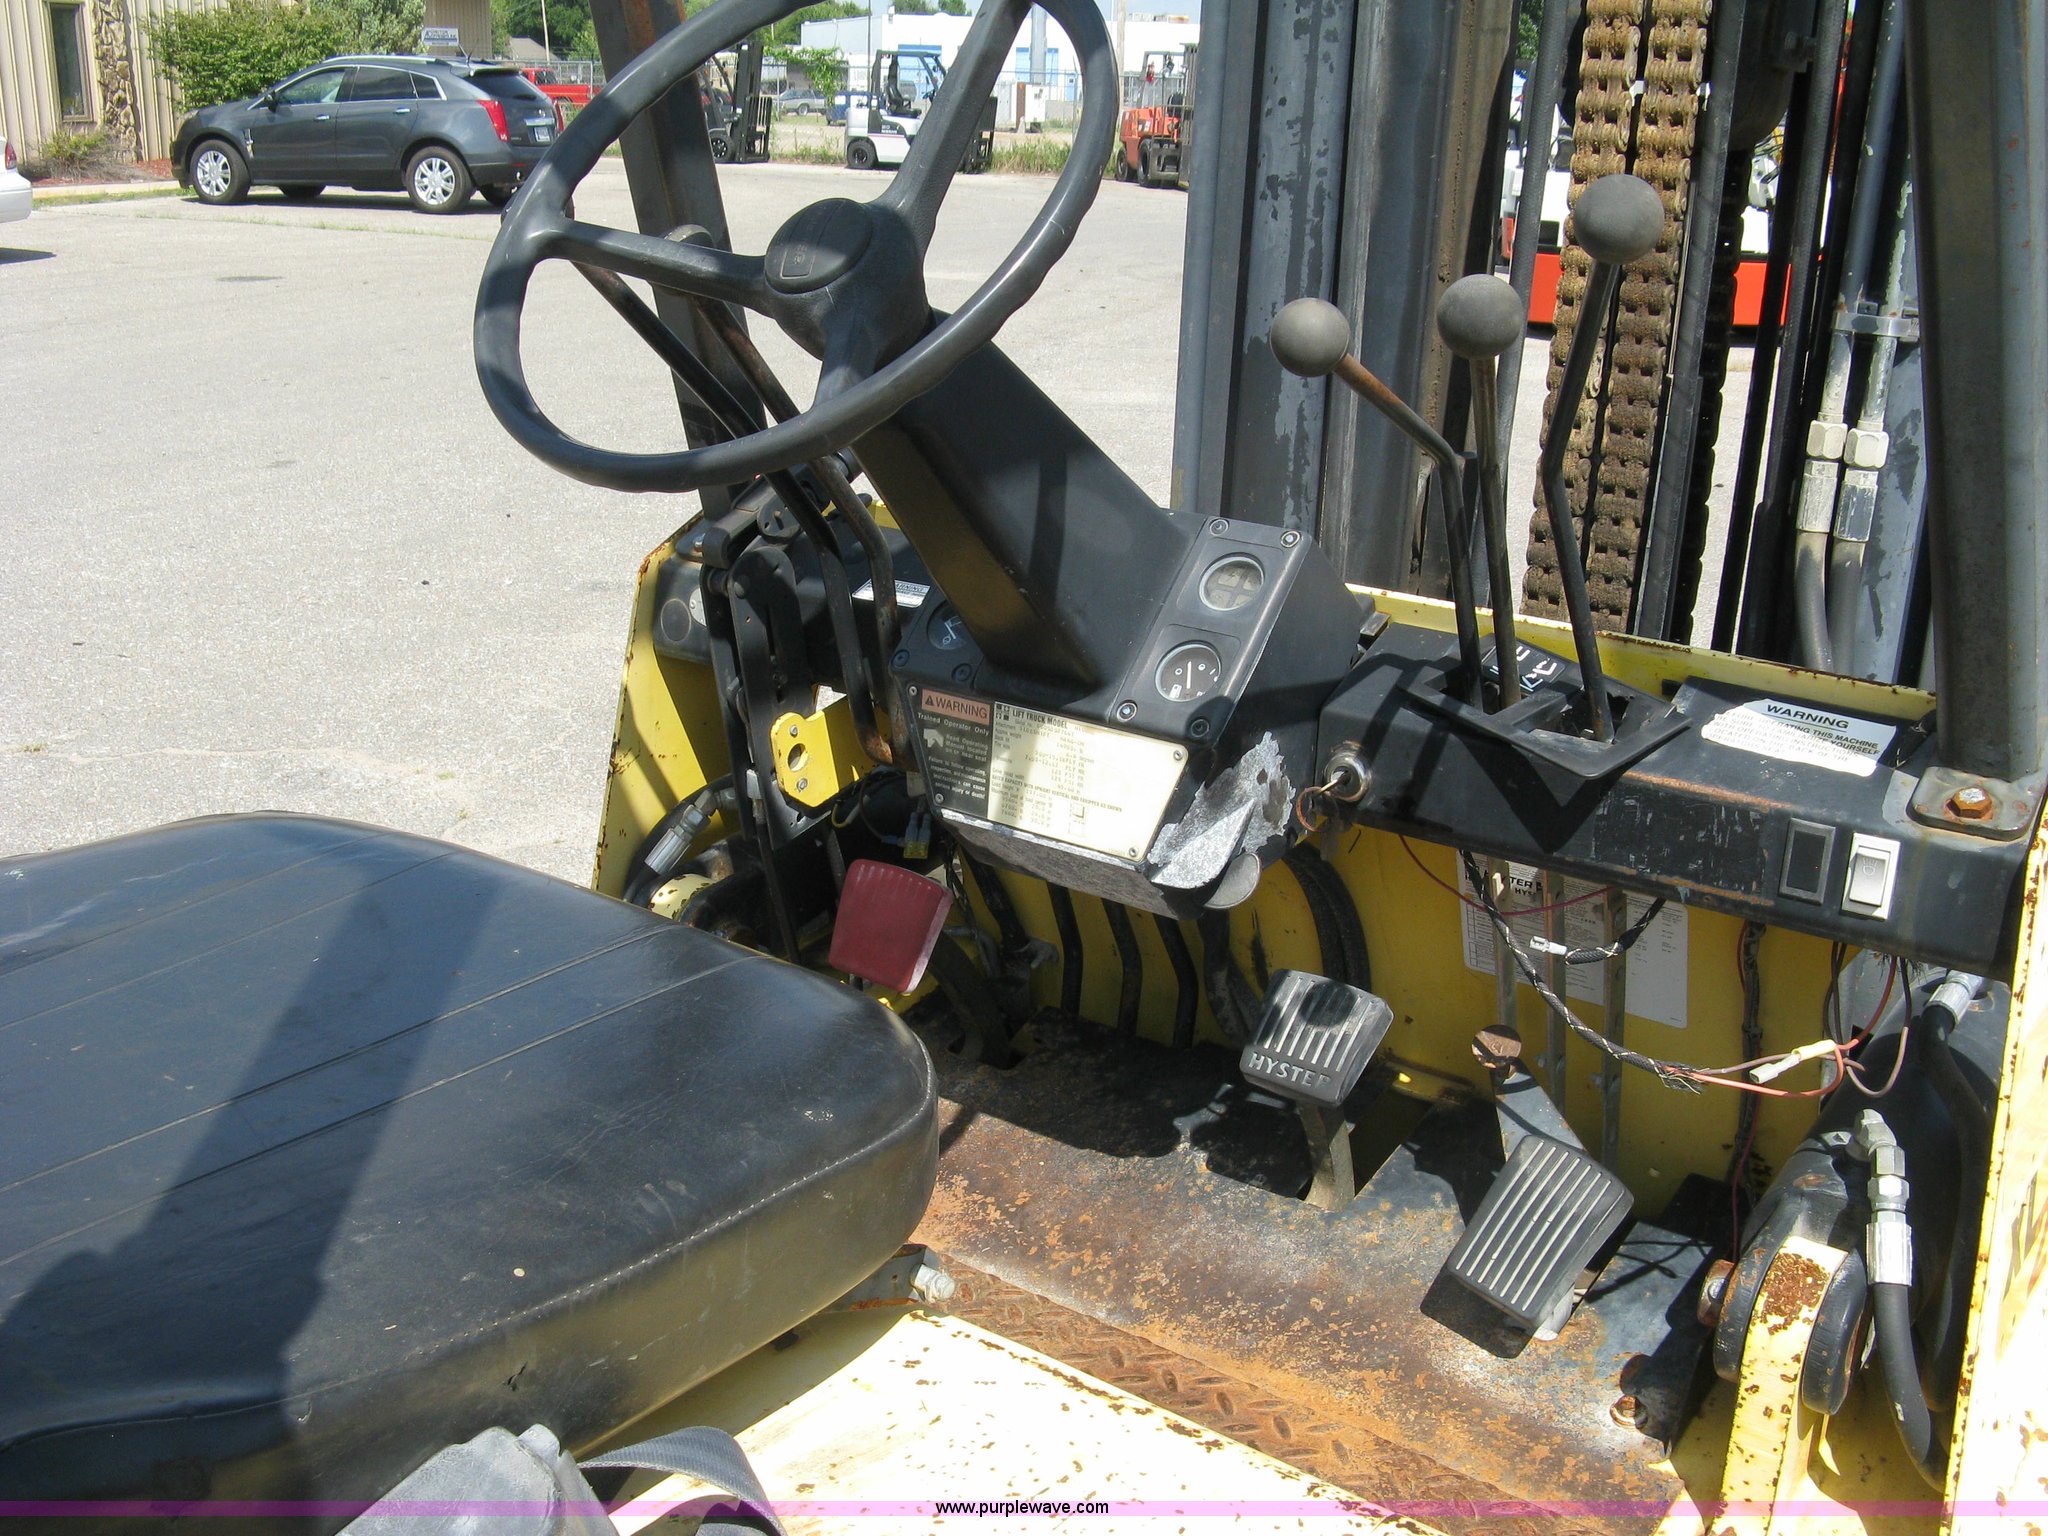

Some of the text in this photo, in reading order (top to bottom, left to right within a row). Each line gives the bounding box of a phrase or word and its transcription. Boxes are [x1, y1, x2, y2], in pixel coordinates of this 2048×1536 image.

[936, 697, 987, 719] WARNING
[1767, 704, 1849, 729] WARNING
[917, 712, 941, 724] Trained
[944, 719, 972, 731] Operator
[974, 726, 990, 737] Only
[1012, 709, 1024, 718] LIFT
[1026, 712, 1045, 723] TRUCK
[1046, 717, 1068, 729] MODEL
[1813, 729, 1833, 739] THIS
[1835, 734, 1878, 749] MACHINE
[1829, 740, 1880, 754] YOURSELF
